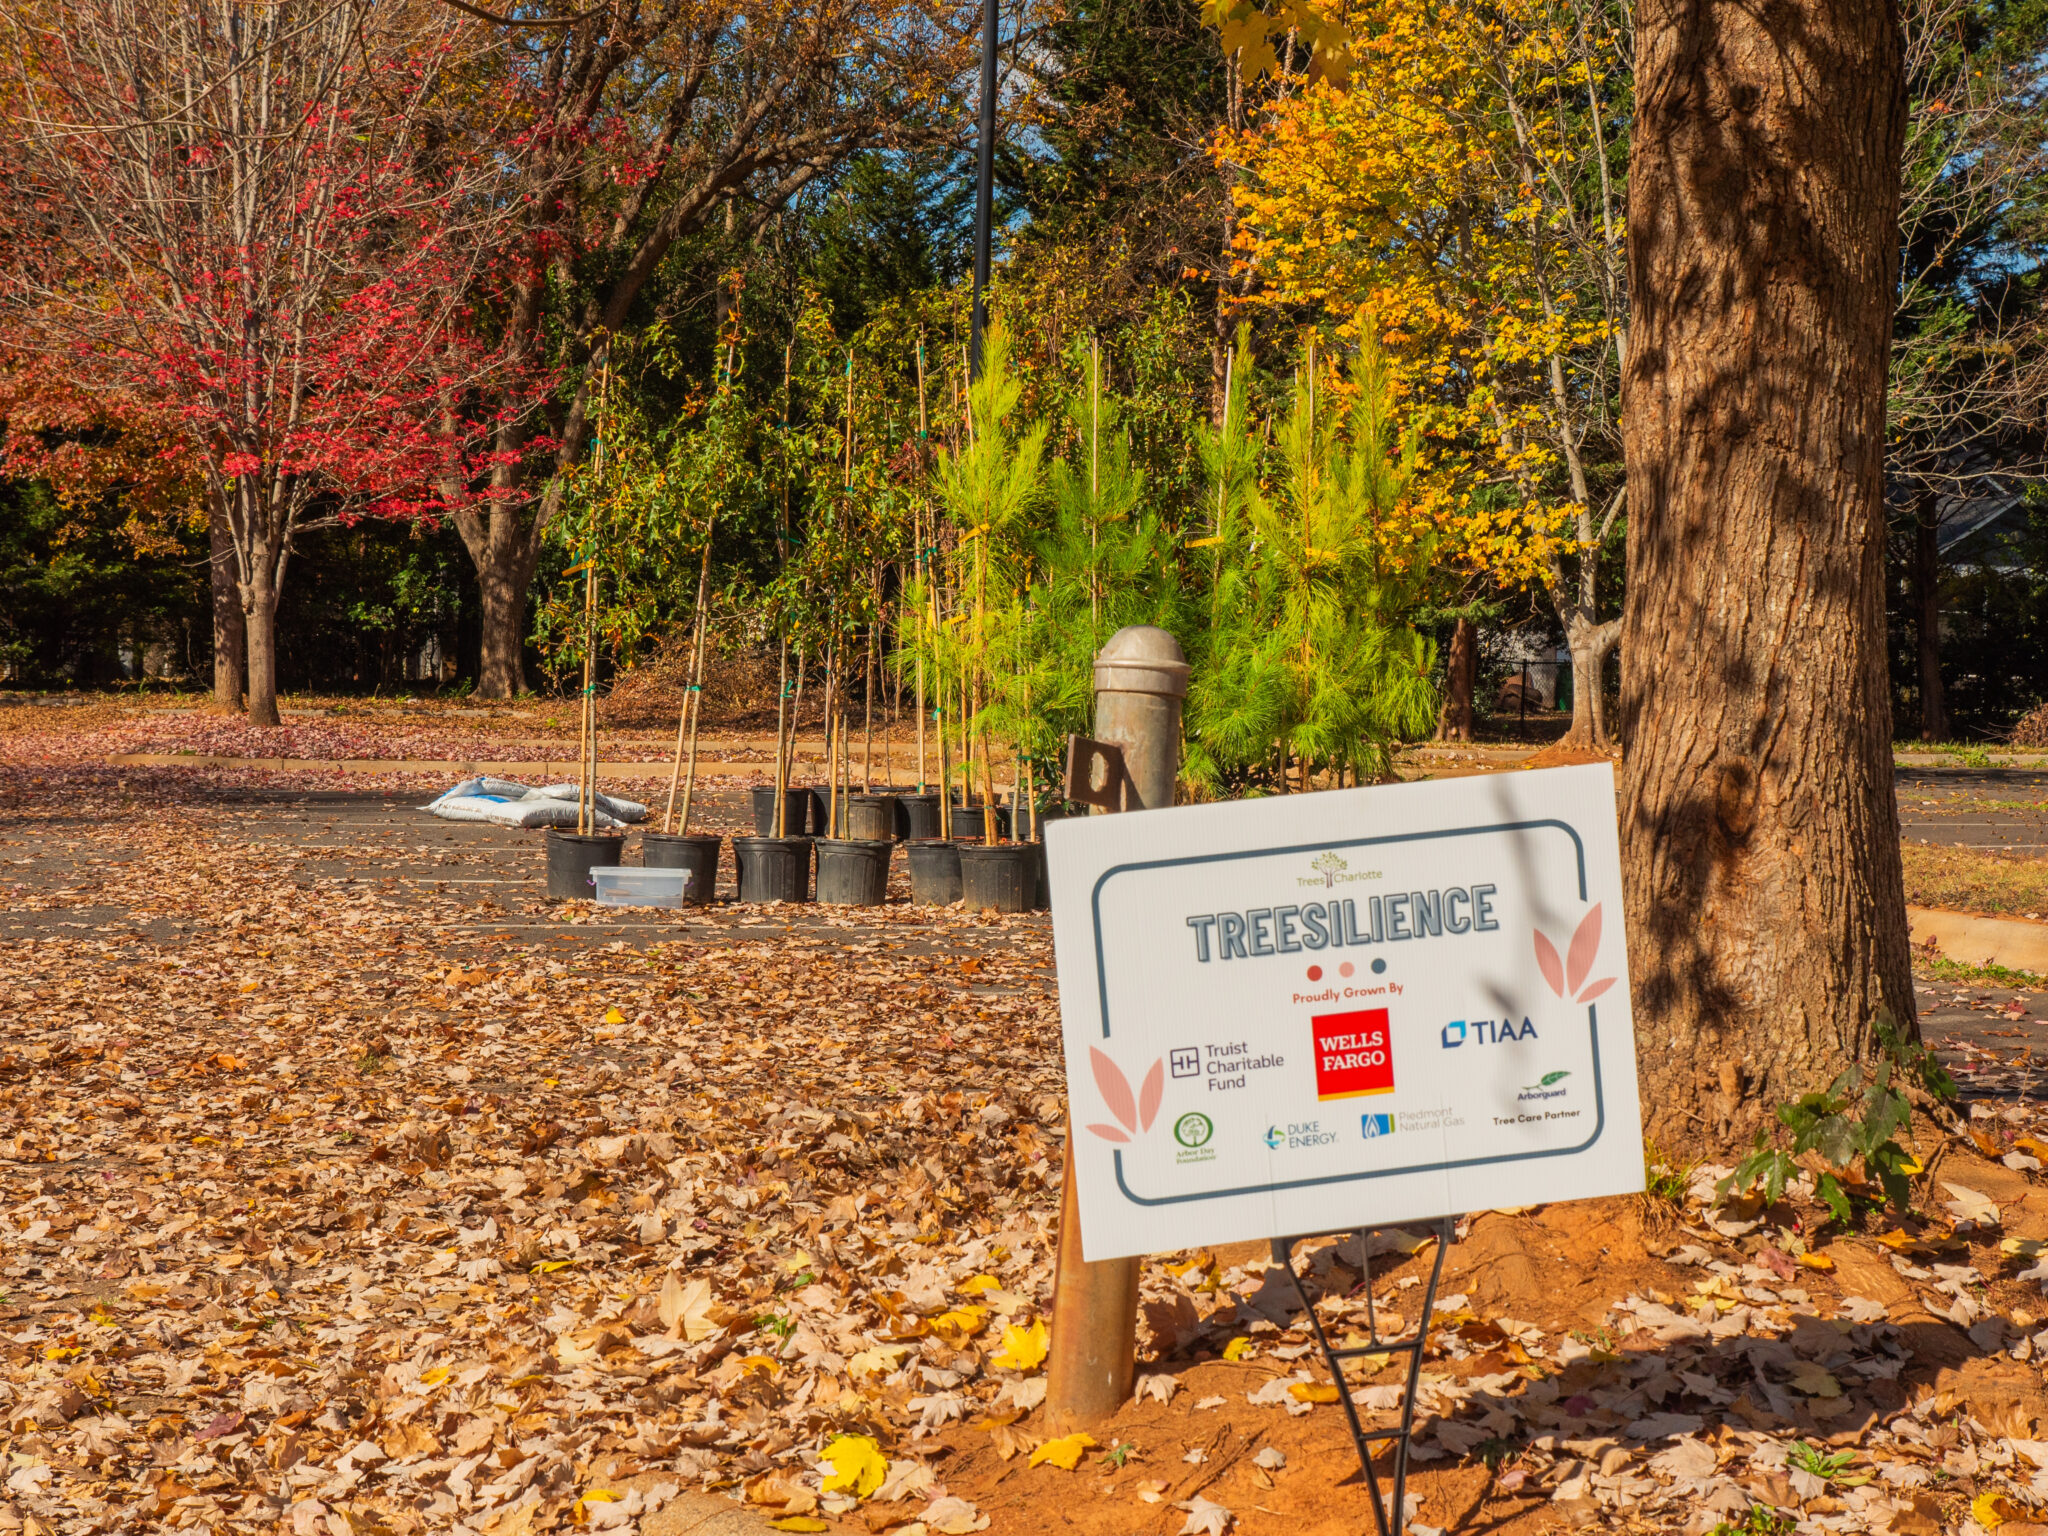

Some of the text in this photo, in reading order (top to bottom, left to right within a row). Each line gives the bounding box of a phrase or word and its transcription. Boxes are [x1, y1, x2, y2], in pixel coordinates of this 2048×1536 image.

[1296, 869, 1383, 888] Trees Charlotte
[1187, 884, 1499, 962] TREESILIENCE
[1293, 982, 1404, 1005] Proudly Grown By
[1471, 1016, 1538, 1045] TIAA
[1205, 1041, 1249, 1059] Truist
[1319, 1031, 1384, 1052] WELLS
[1206, 1053, 1285, 1075] Charitable
[1322, 1050, 1386, 1072] FARGO
[1208, 1075, 1247, 1092] Fund
[1517, 1088, 1567, 1102] Arborguard
[1399, 1106, 1453, 1121] Piedmont
[1493, 1109, 1581, 1126] Tree Care Partner
[1287, 1121, 1321, 1136] DUKE
[1400, 1116, 1466, 1132] Natural Gas
[1289, 1132, 1338, 1149] ENERGY
